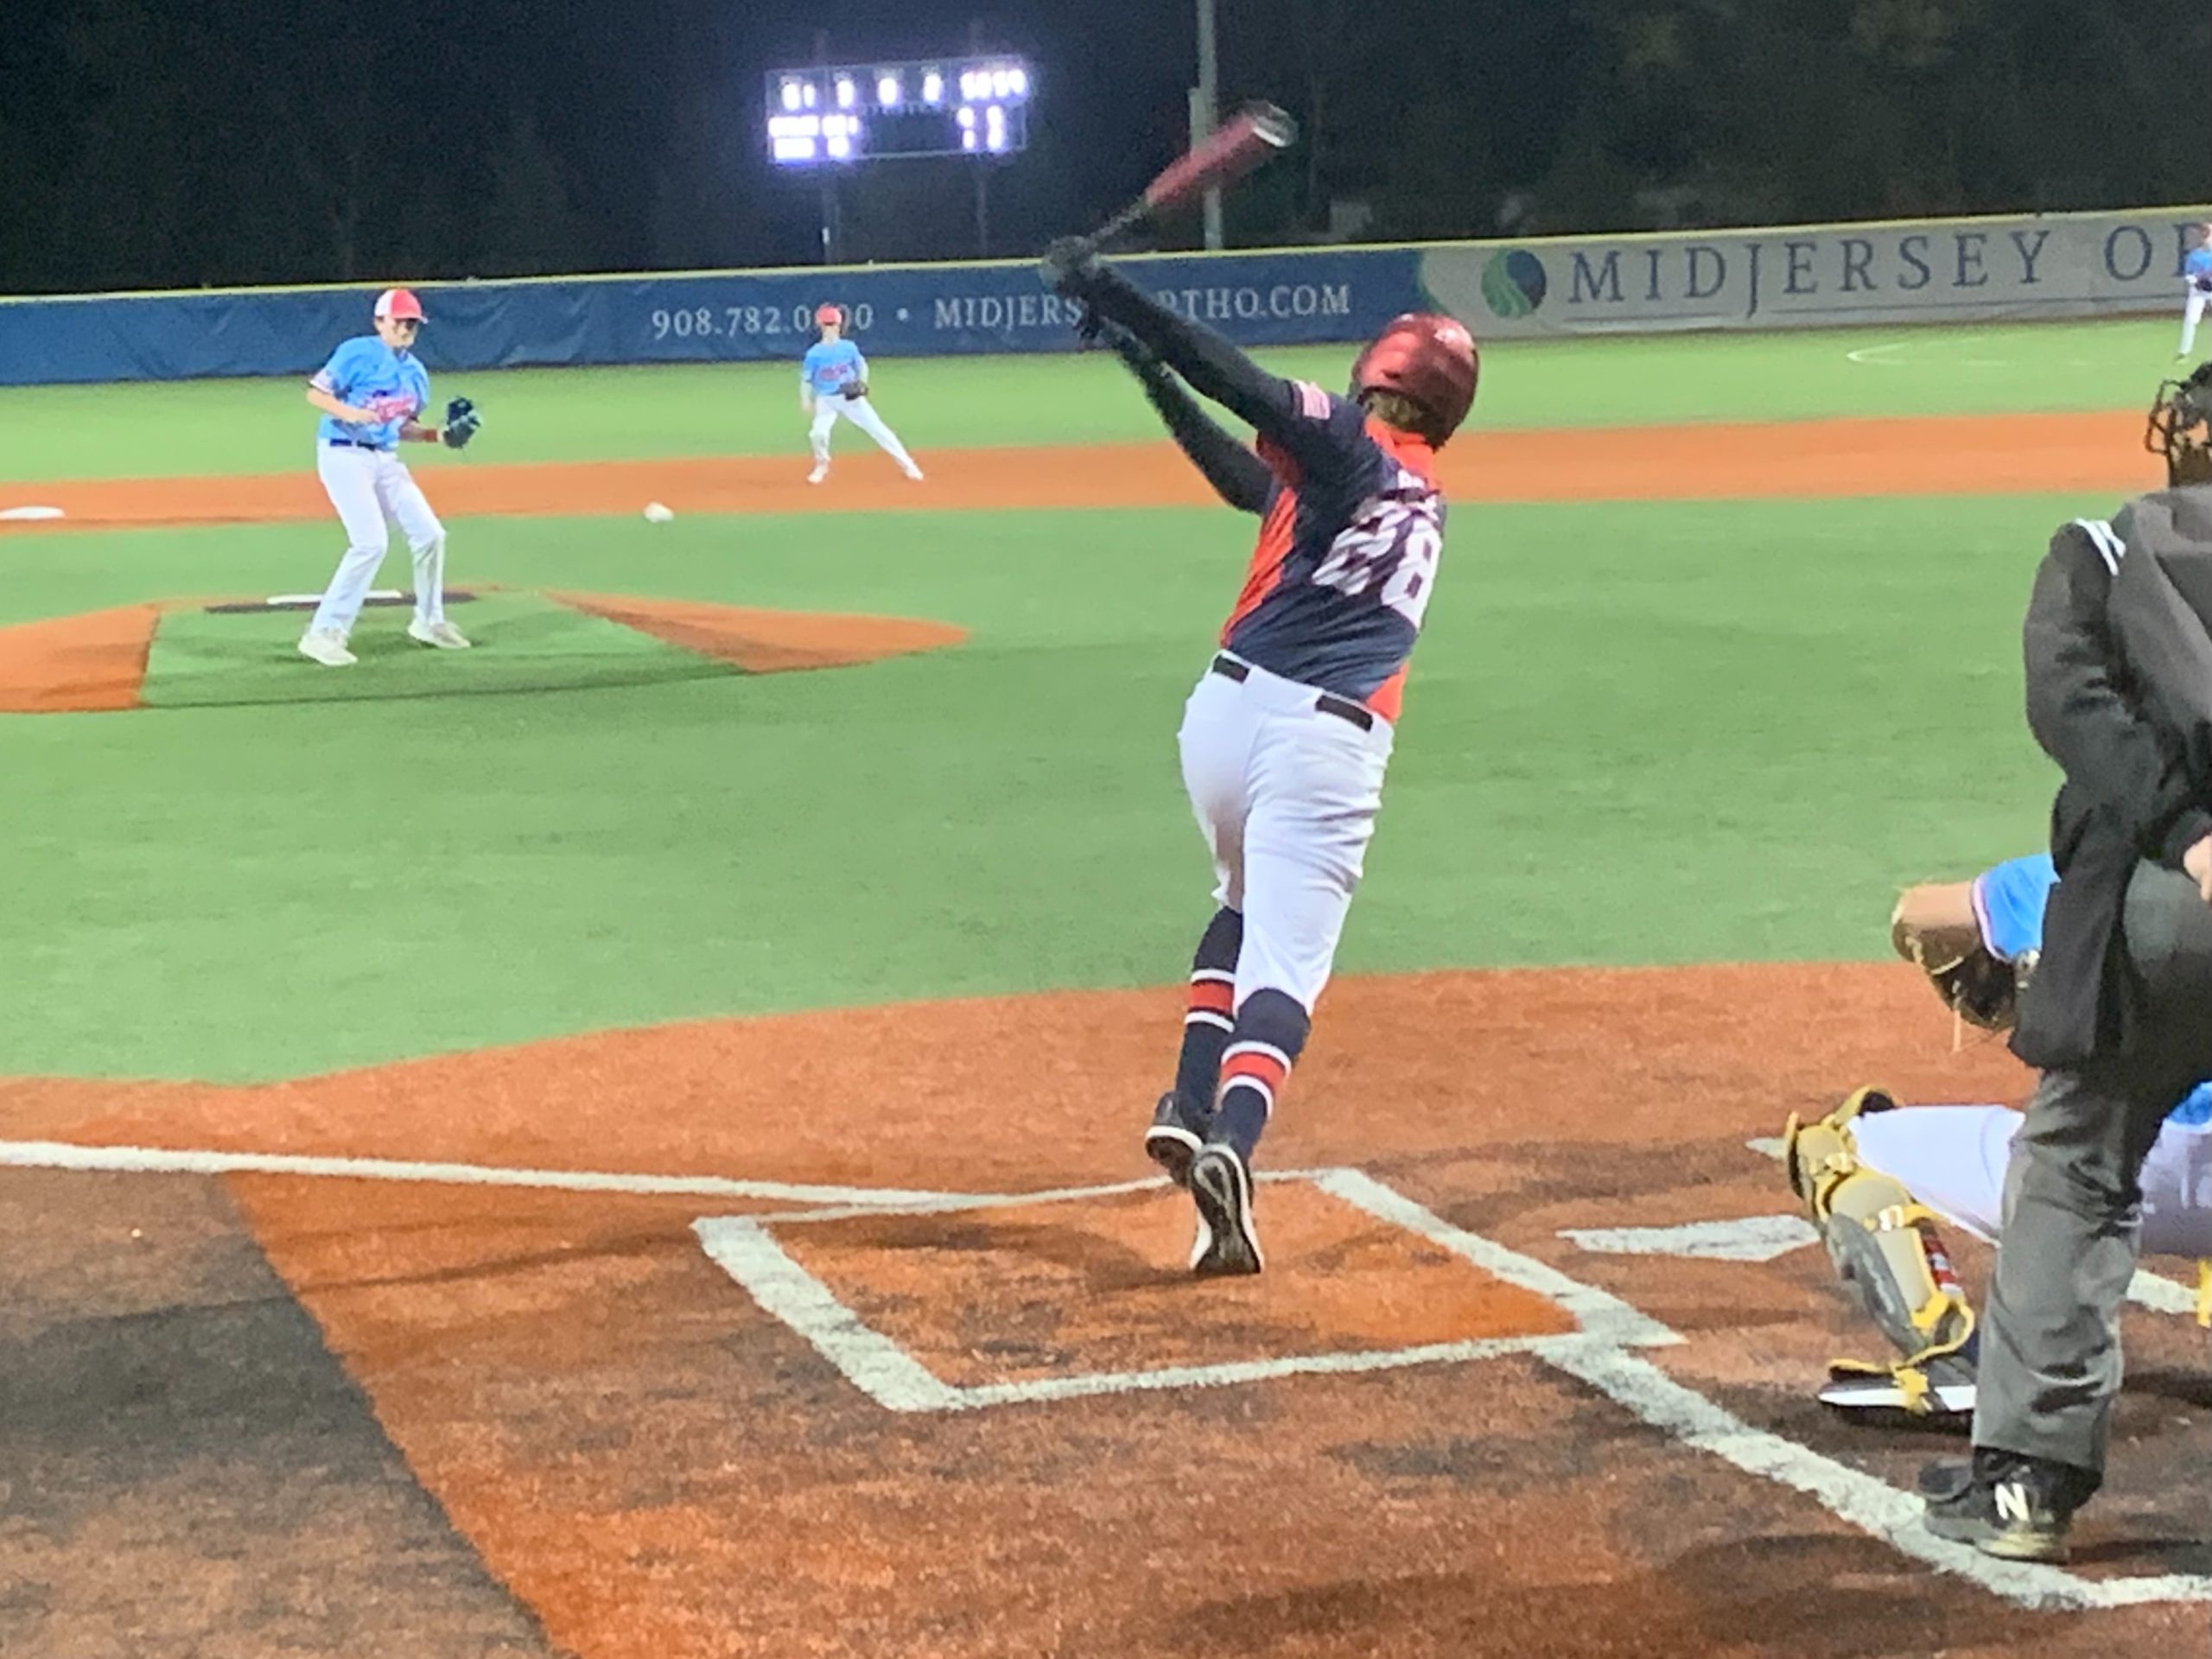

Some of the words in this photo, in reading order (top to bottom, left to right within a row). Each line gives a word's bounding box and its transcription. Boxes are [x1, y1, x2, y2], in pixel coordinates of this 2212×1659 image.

[1568, 231, 2051, 318] MIDJERSEY
[653, 303, 873, 339] 908.782.000
[1995, 1483, 2029, 1522] N
